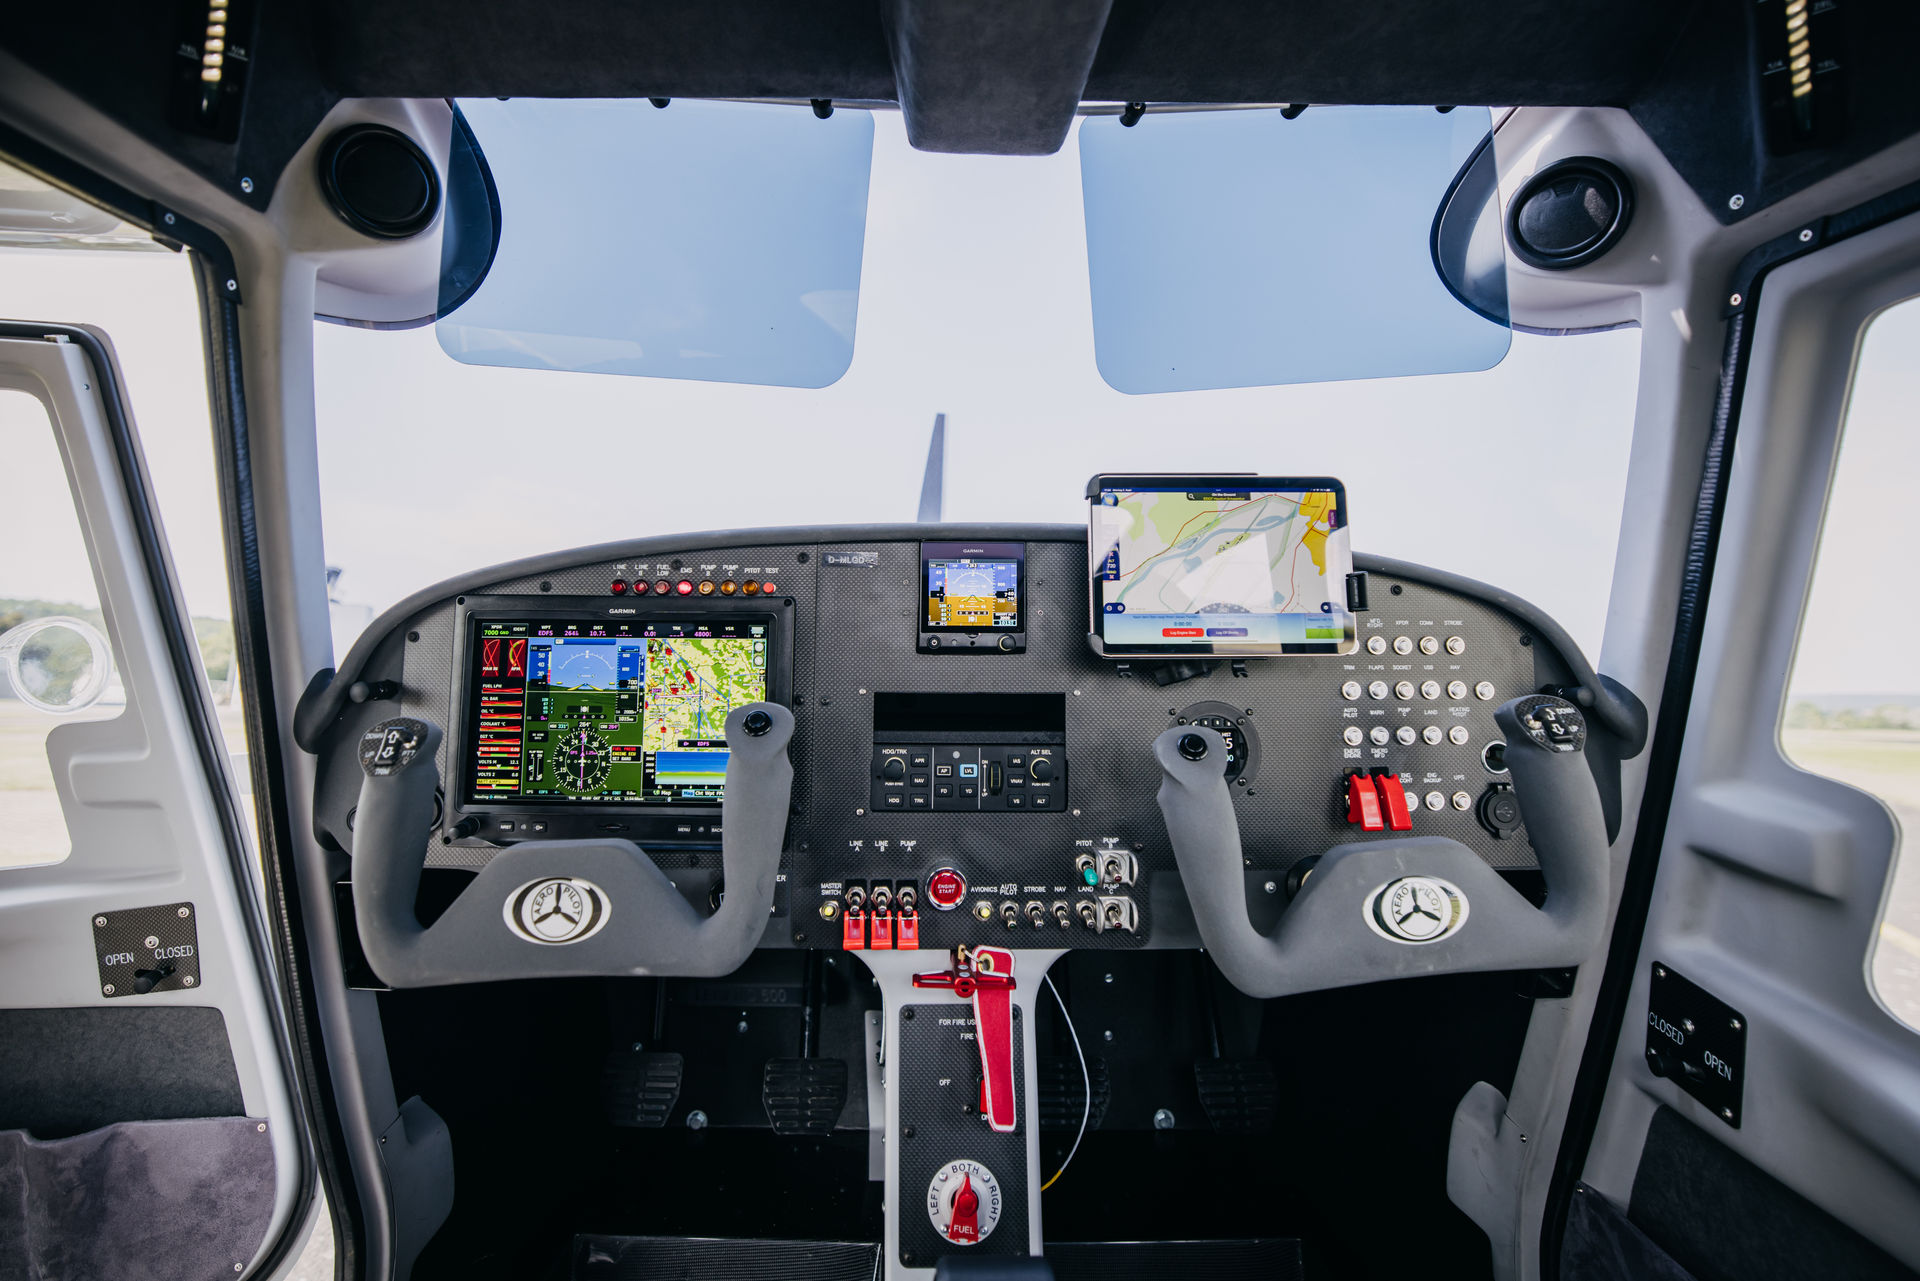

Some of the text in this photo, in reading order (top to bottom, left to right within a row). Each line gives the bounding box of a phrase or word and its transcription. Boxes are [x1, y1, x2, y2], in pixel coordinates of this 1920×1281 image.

[534, 887, 581, 915] AERO PILOT
[1395, 887, 1409, 916] AERO
[105, 952, 134, 966] OPEN
[154, 945, 193, 960] CLOSED
[1649, 1011, 1684, 1045] CLOSED
[1704, 1050, 1732, 1082] OPEN
[952, 1163, 980, 1174] BOTH
[930, 1186, 939, 1216] LEFT
[989, 1185, 1000, 1222] RIGHT
[953, 1225, 975, 1234] FUEL
